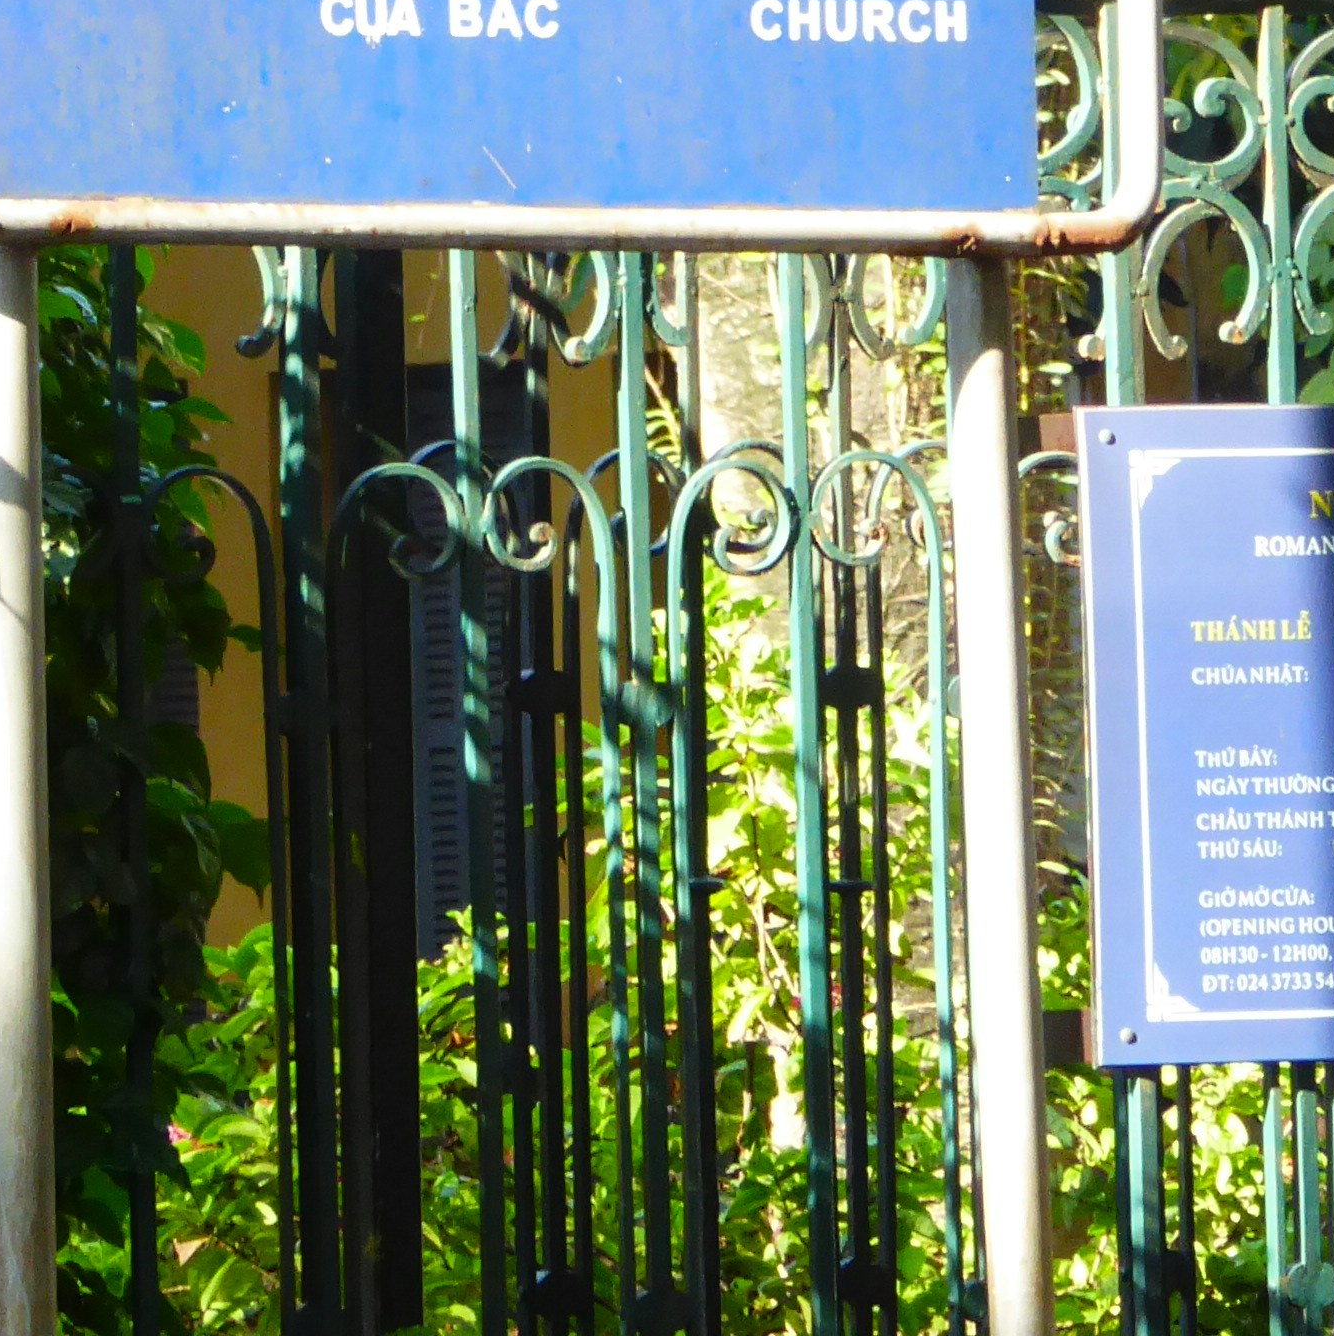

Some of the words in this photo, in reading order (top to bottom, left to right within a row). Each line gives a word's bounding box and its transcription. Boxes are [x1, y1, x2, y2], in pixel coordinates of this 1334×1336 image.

[1191, 614, 1277, 642] THÁNH
[1281, 610, 1312, 640] LỄ
[1191, 664, 1249, 685] CHÚA
[1250, 663, 1309, 686] NHẬT:
[1195, 748, 1235, 768] THỨ
[1239, 745, 1278, 767] BẢY:
[1197, 776, 1253, 796] NGÀY
[1255, 808, 1323, 829] THÁNH
[1197, 838, 1242, 859] THỨ
[1243, 838, 1283, 858] SÁU:
[1271, 884, 1315, 906] CỬA:
[1200, 917, 1295, 936] (OPENING
[1201, 946, 1258, 964] 08H30
[1203, 974, 1235, 993] ĐT:
[1237, 973, 1271, 992] 024
[1271, 972, 1312, 990] 3733
